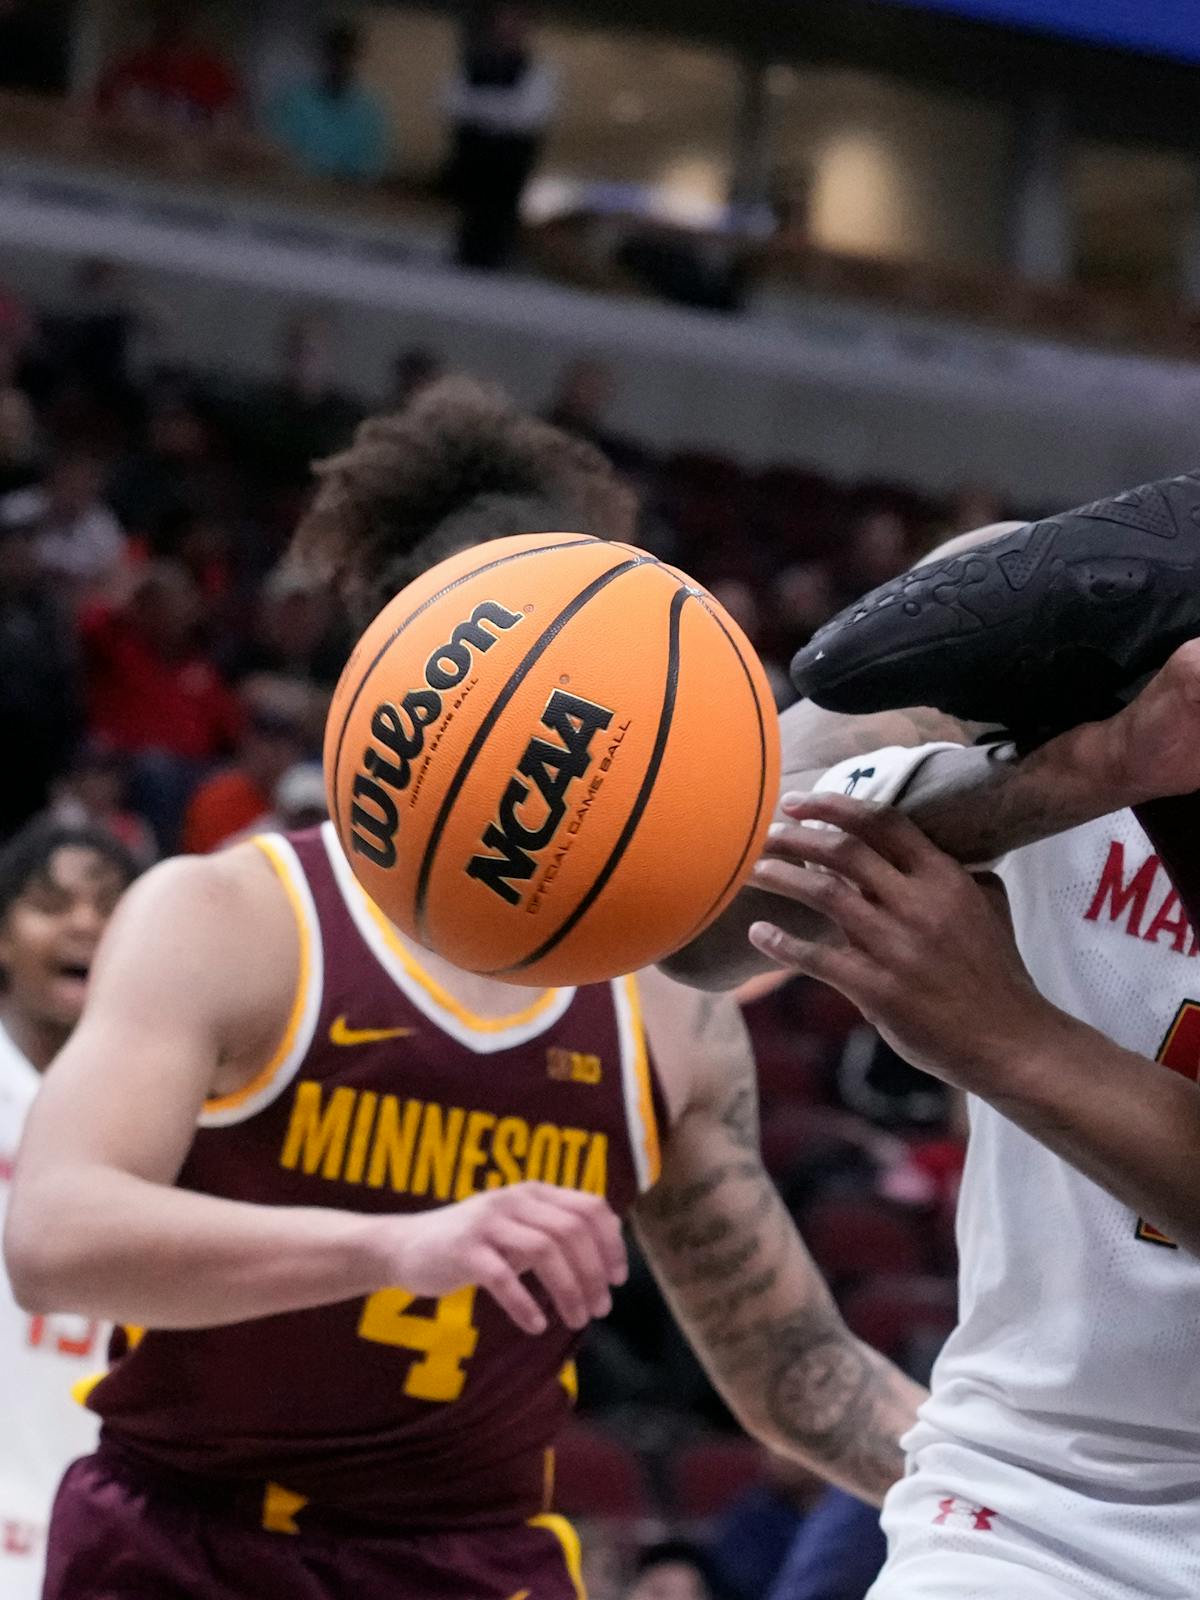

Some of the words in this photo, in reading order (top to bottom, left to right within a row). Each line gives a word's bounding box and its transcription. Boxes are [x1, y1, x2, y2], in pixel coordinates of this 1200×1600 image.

[352, 599, 525, 870] Wilson
[430, 713, 454, 751] GAME
[453, 678, 479, 709] BALL
[464, 688, 615, 906] NCAA
[526, 838, 573, 915] OFFICIAL
[568, 775, 604, 835] GAME
[600, 720, 632, 773] BALL
[280, 1080, 608, 1202] MINNESOTA
[358, 1284, 479, 1401] 4
